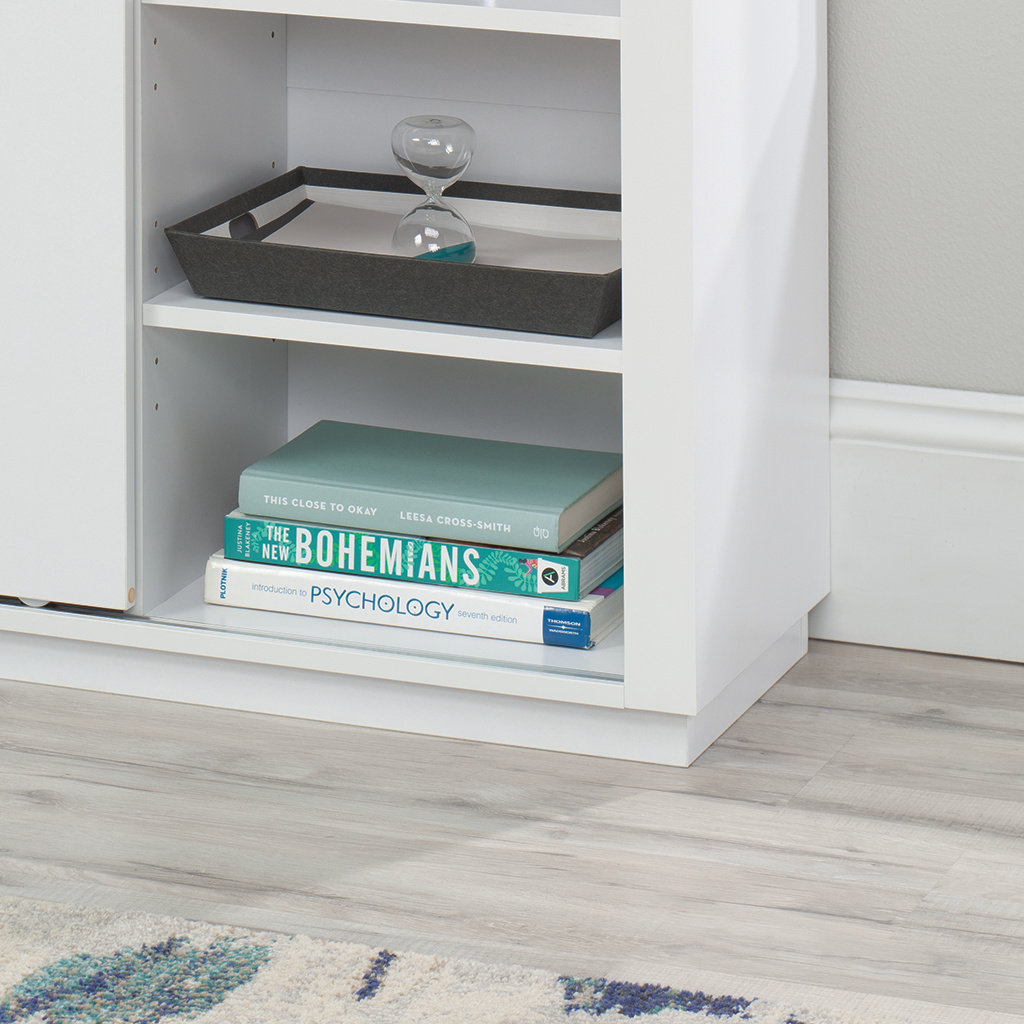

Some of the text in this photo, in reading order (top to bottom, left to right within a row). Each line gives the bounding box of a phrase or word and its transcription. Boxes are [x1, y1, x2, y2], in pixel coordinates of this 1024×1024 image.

[264, 495, 378, 516] THIS CLOSE TO OKAY
[400, 511, 511, 533] LEESA CROSS-SMITH
[244, 522, 252, 558] BLAKENEY
[267, 525, 290, 543] THE
[262, 543, 290, 562] NEW
[295, 527, 480, 586] BOHEMIANS
[220, 568, 228, 599] PLOTNIK
[251, 583, 518, 625] introduction to PSYCHOLOGY seventh edition
[547, 618, 581, 627] THOMSON
